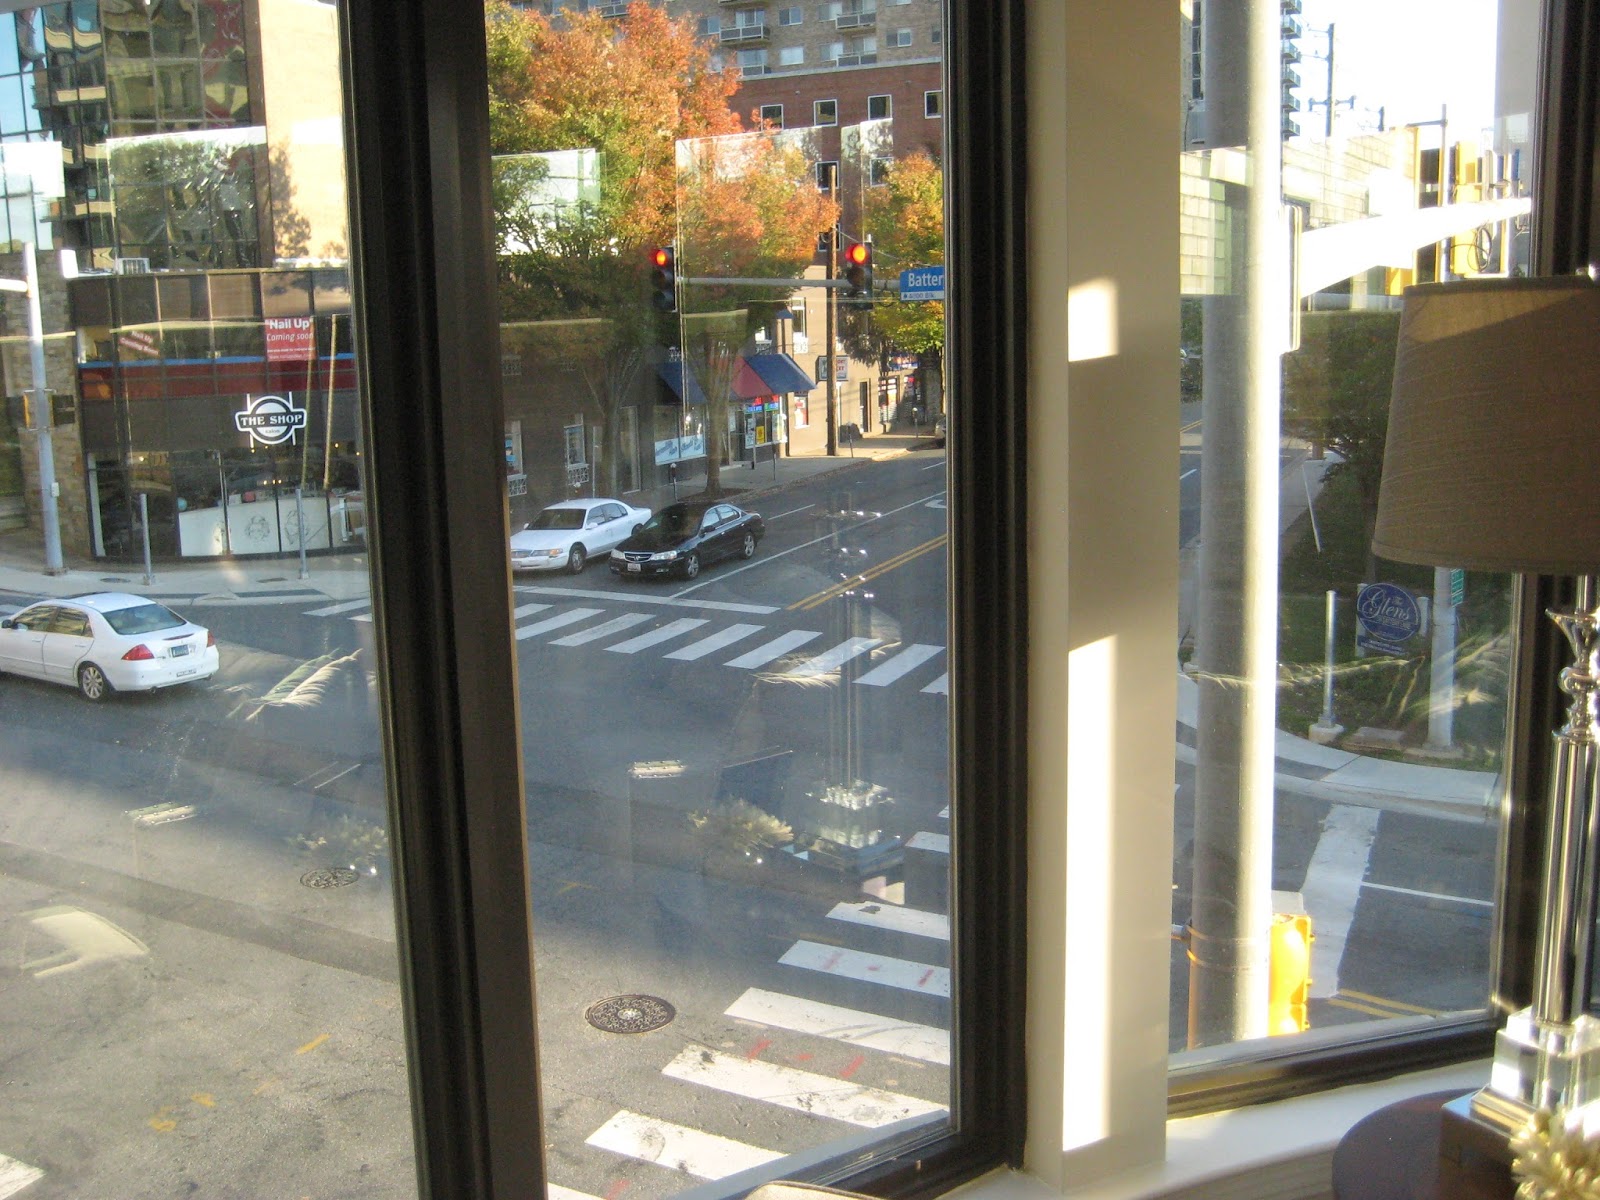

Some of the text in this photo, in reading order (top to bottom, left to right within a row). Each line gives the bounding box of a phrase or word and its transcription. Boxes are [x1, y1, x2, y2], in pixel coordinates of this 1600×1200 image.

[266, 333, 295, 343] Coming
[240, 415, 302, 426] THE SHOP
